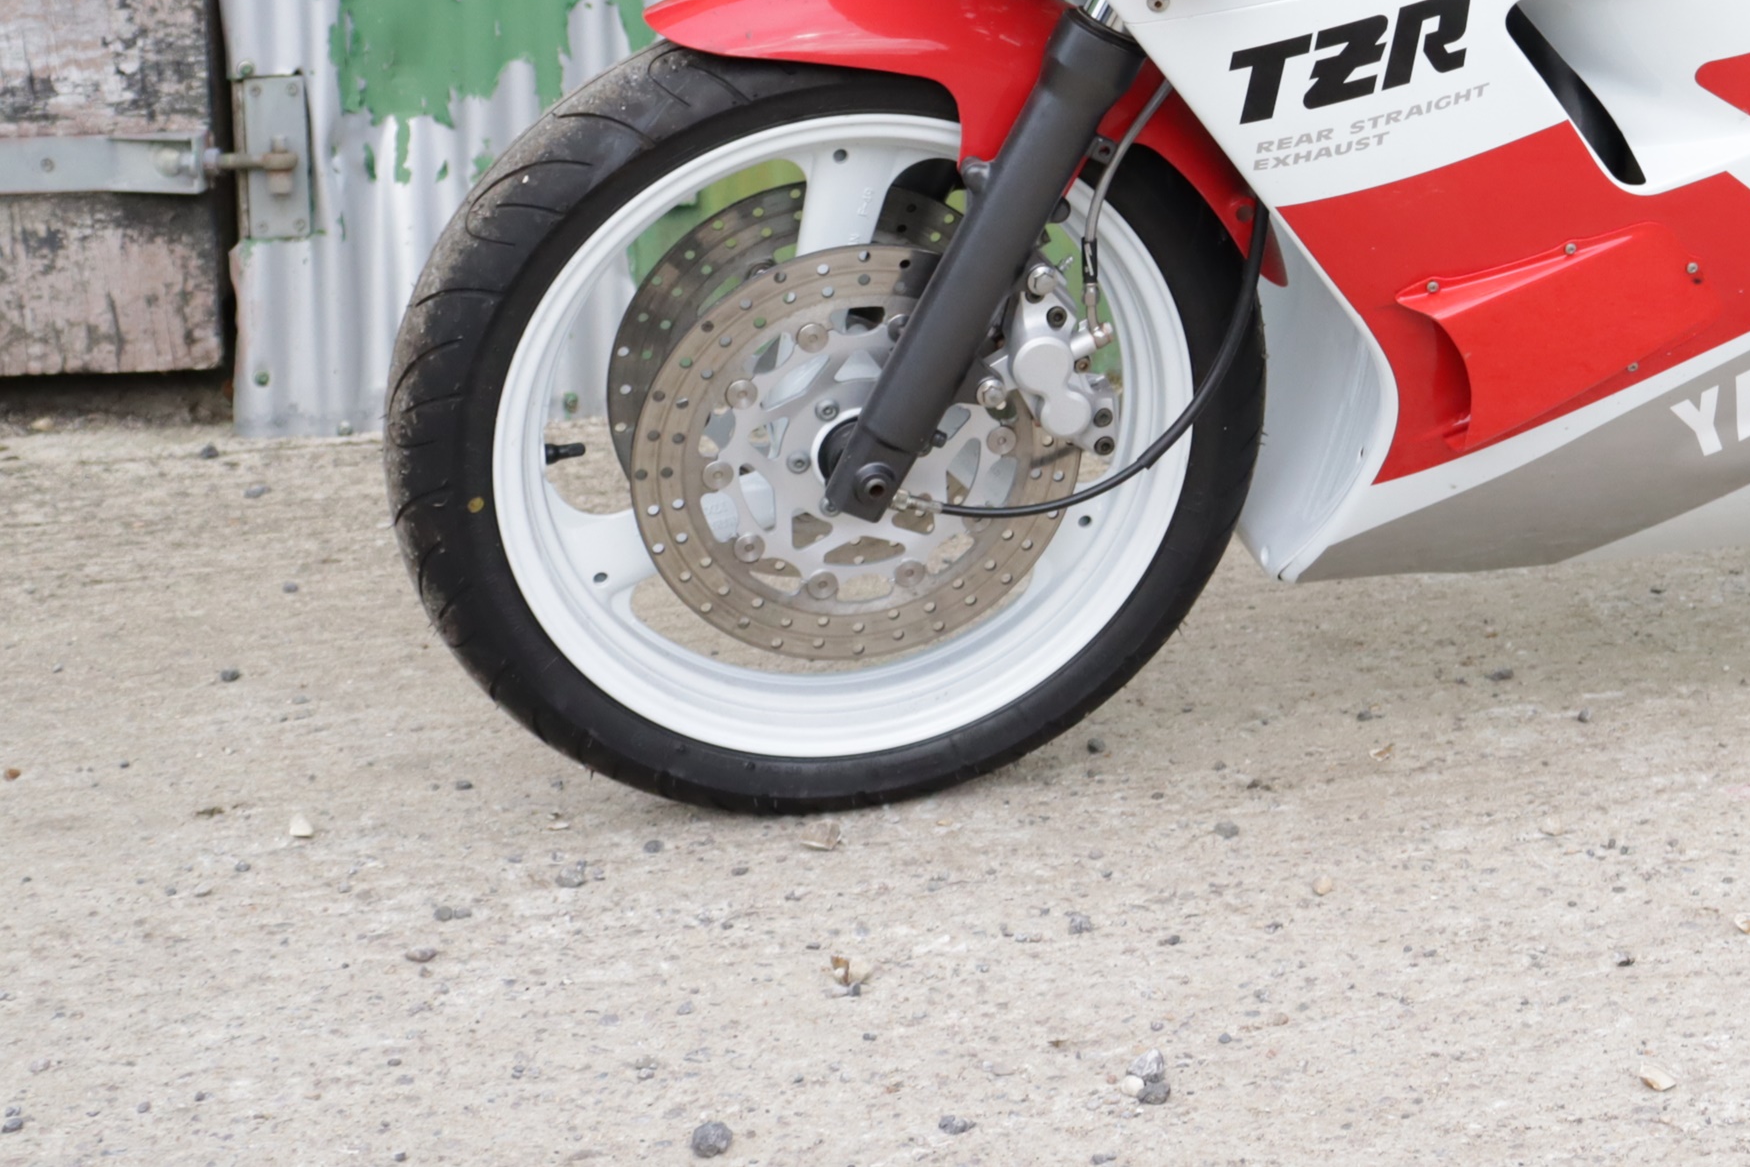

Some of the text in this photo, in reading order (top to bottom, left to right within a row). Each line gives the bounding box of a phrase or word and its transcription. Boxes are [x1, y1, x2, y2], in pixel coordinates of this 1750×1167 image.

[1256, 82, 1491, 154] REAR STRAIGHT
[1253, 131, 1390, 171] EXHAUST
